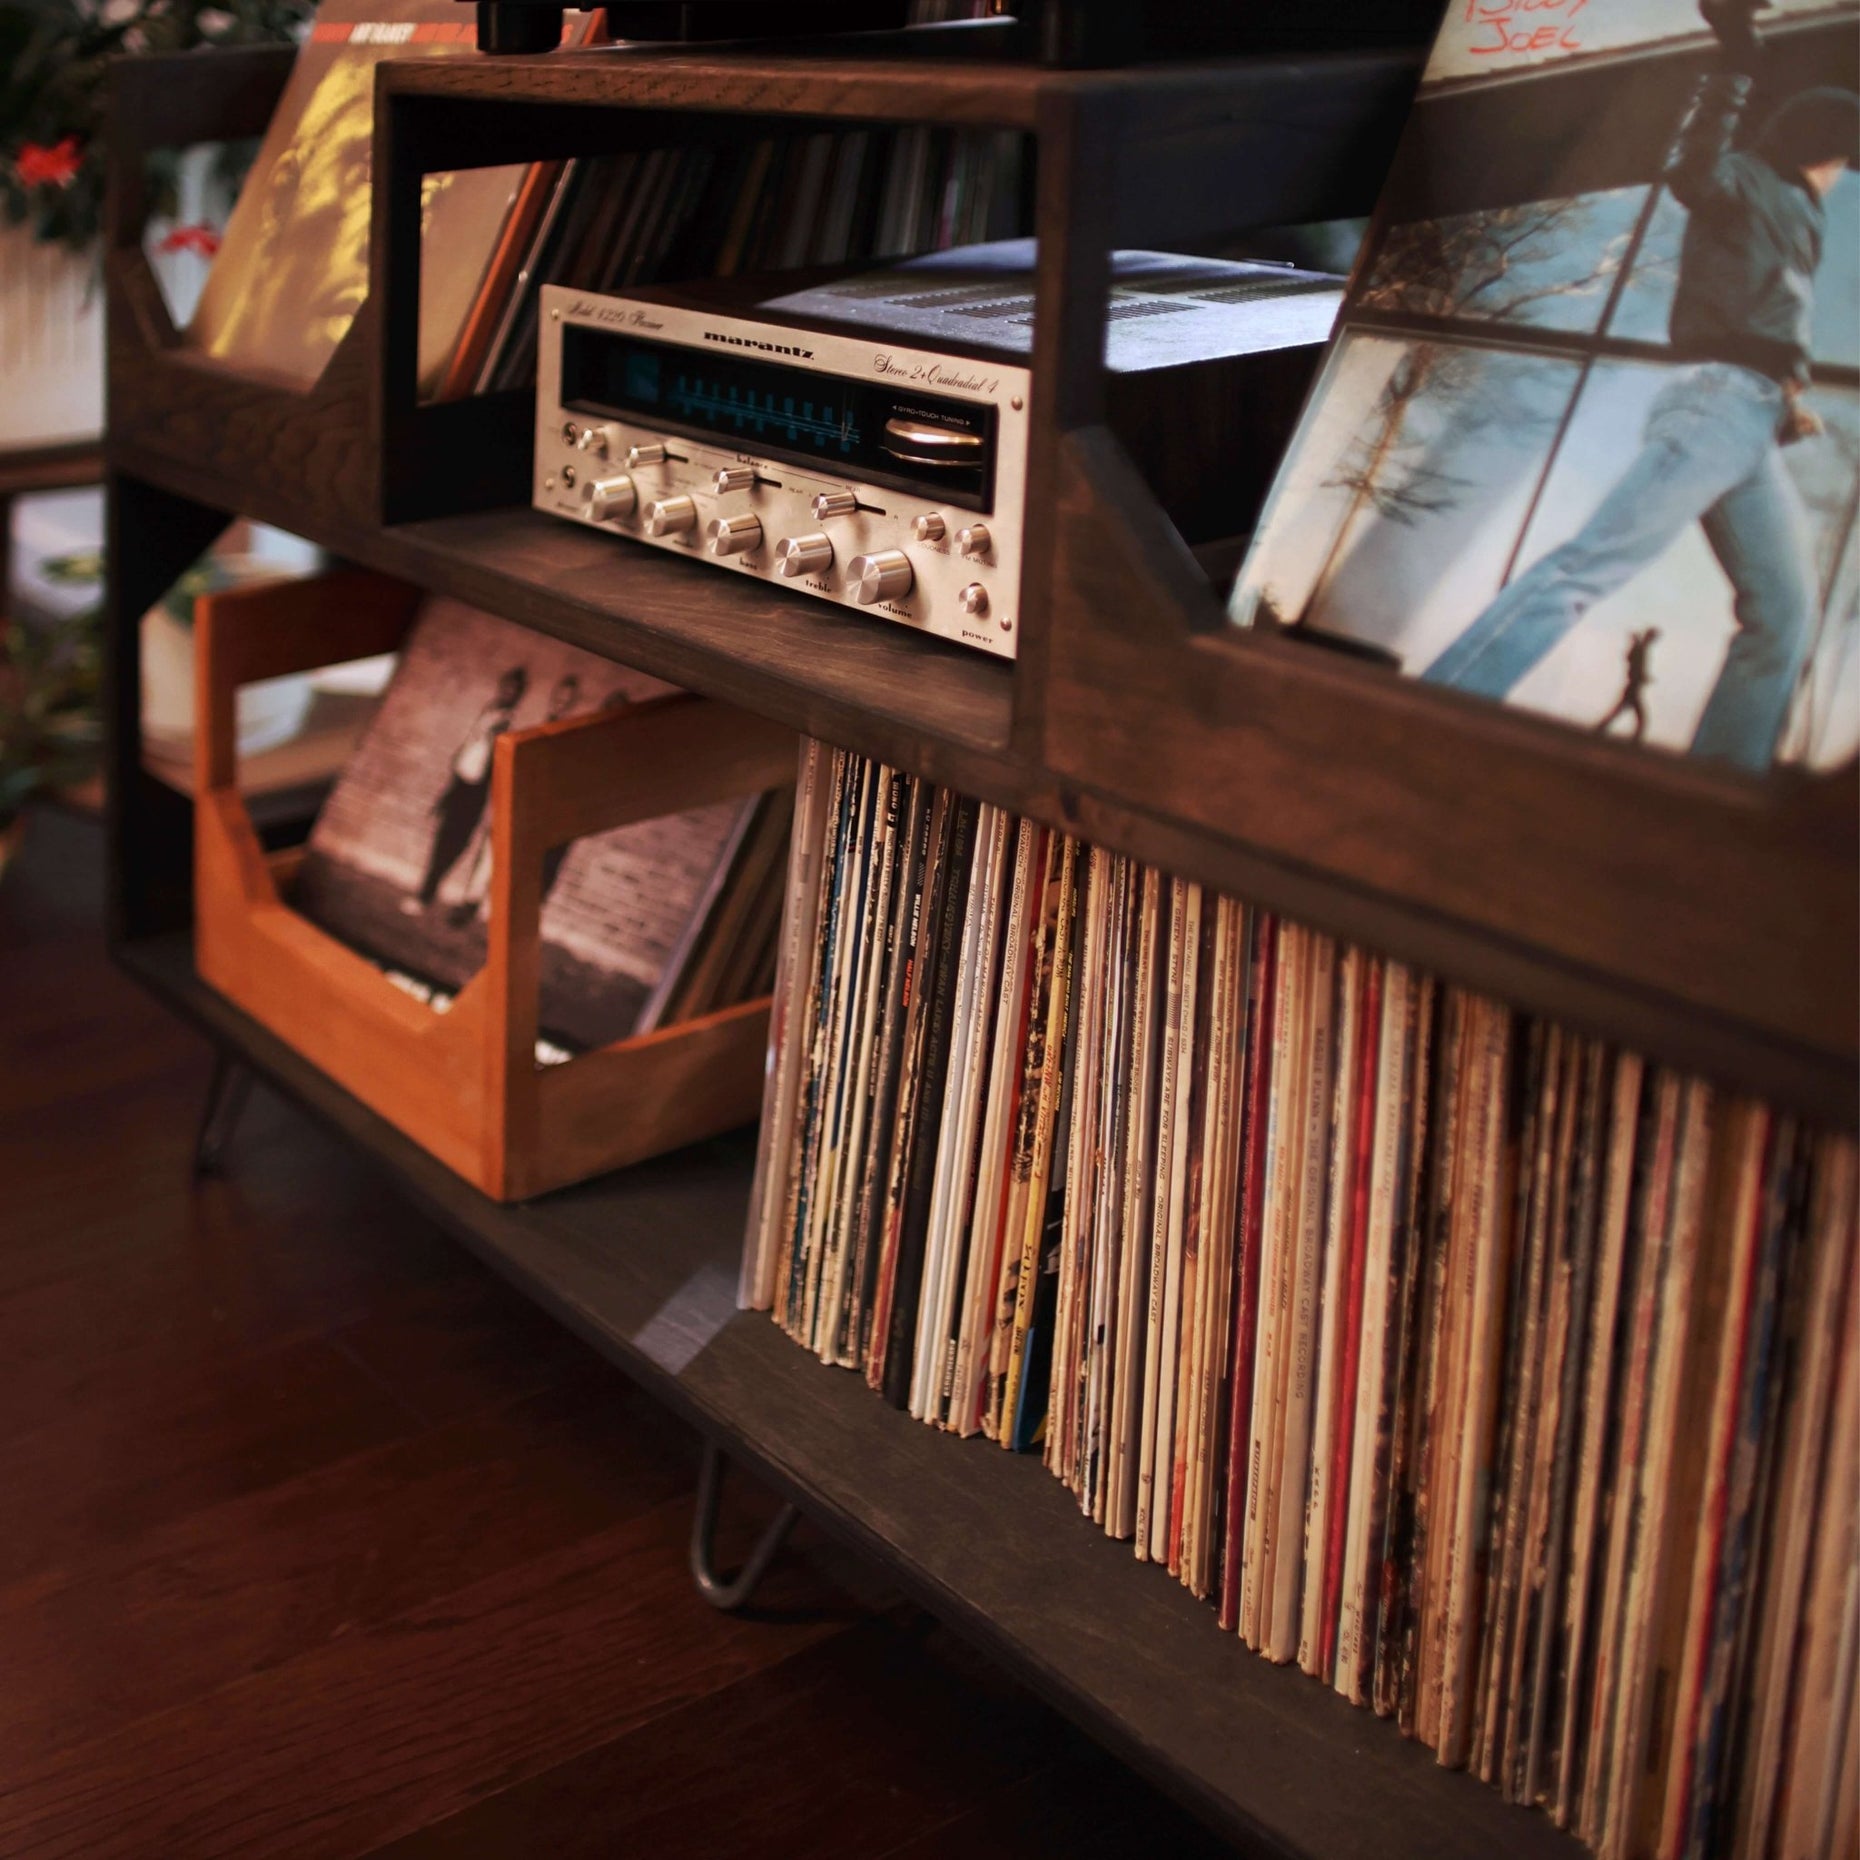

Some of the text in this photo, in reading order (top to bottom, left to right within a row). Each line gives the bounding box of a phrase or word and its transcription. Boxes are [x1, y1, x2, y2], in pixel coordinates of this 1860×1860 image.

[1469, 18, 1581, 54] JOEL
[704, 331, 814, 360] marantz
[874, 353, 907, 378] Stereo
[941, 414, 965, 426] TUNING
[736, 453, 768, 469] balance
[740, 556, 758, 571] bass
[806, 578, 832, 594] treble
[878, 602, 913, 620] volume
[962, 628, 994, 645] power
[909, 894, 921, 946] WILLIE NELSON
[1001, 820, 1029, 1005] TOVARICH ORIGINAL BROADWAY CAST
[1173, 907, 1182, 941] GREEN
[1187, 919, 1195, 933] THE
[1170, 953, 1178, 985] STYNE
[1185, 935, 1194, 977] PENTANGLE
[1164, 1035, 1174, 1082] SUBWAYS
[1313, 1026, 1324, 1072] MAGGIE
[1311, 1078, 1321, 1117] FLYNN
[1161, 1109, 1169, 1128] FOR
[1158, 1133, 1167, 1179] SLEEPING
[1308, 1138, 1318, 1159] THE
[1306, 1166, 1316, 1222] ORIGINAL
[1155, 1195, 1164, 1238] ORIGINAL
[1151, 1243, 1161, 1297] BROADWAY
[1302, 1228, 1313, 1292] BROADWAY
[1150, 1298, 1158, 1324] CAST
[1300, 1297, 1309, 1325] CAST
[1296, 1332, 1307, 1398] RECORDING
